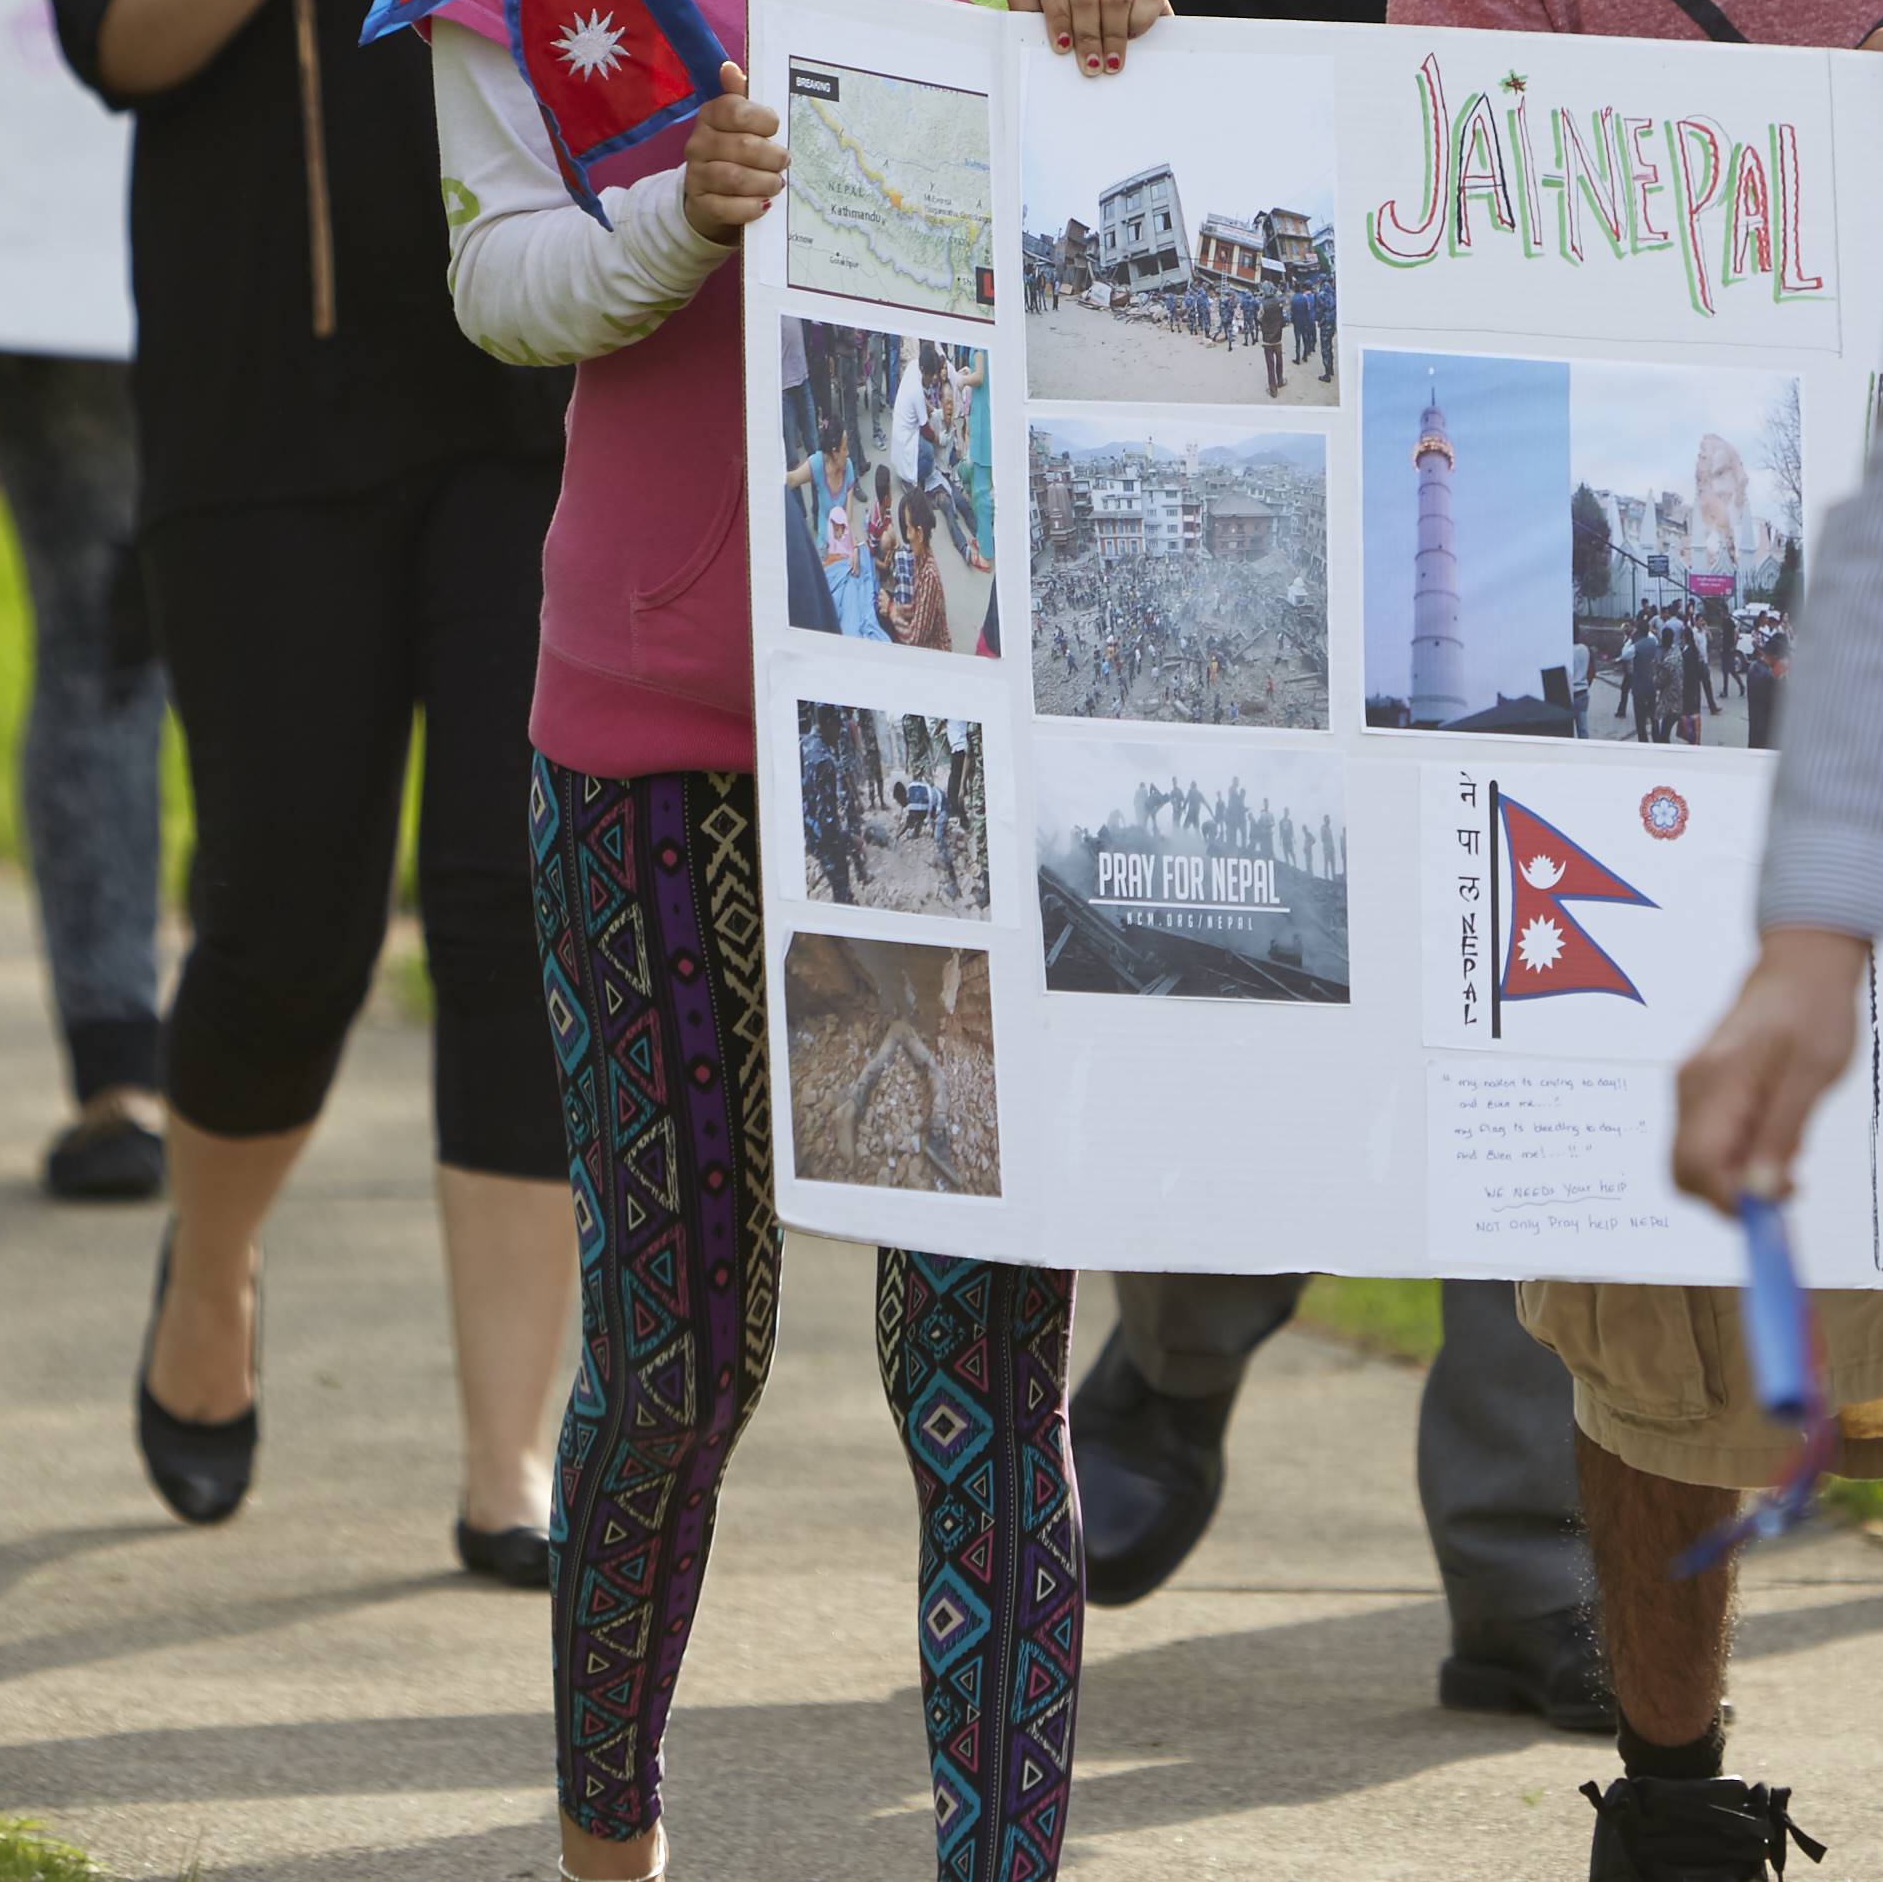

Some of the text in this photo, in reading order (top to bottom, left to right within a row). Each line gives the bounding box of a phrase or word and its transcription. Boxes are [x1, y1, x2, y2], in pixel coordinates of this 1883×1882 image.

[795, 75, 831, 93] BREAKING
[828, 181, 864, 198] NEPAL
[831, 204, 881, 223] Kathmandu
[1098, 852, 1280, 904] PRAY FOR NEPAL
[1462, 913, 1479, 1026] NEPAL
